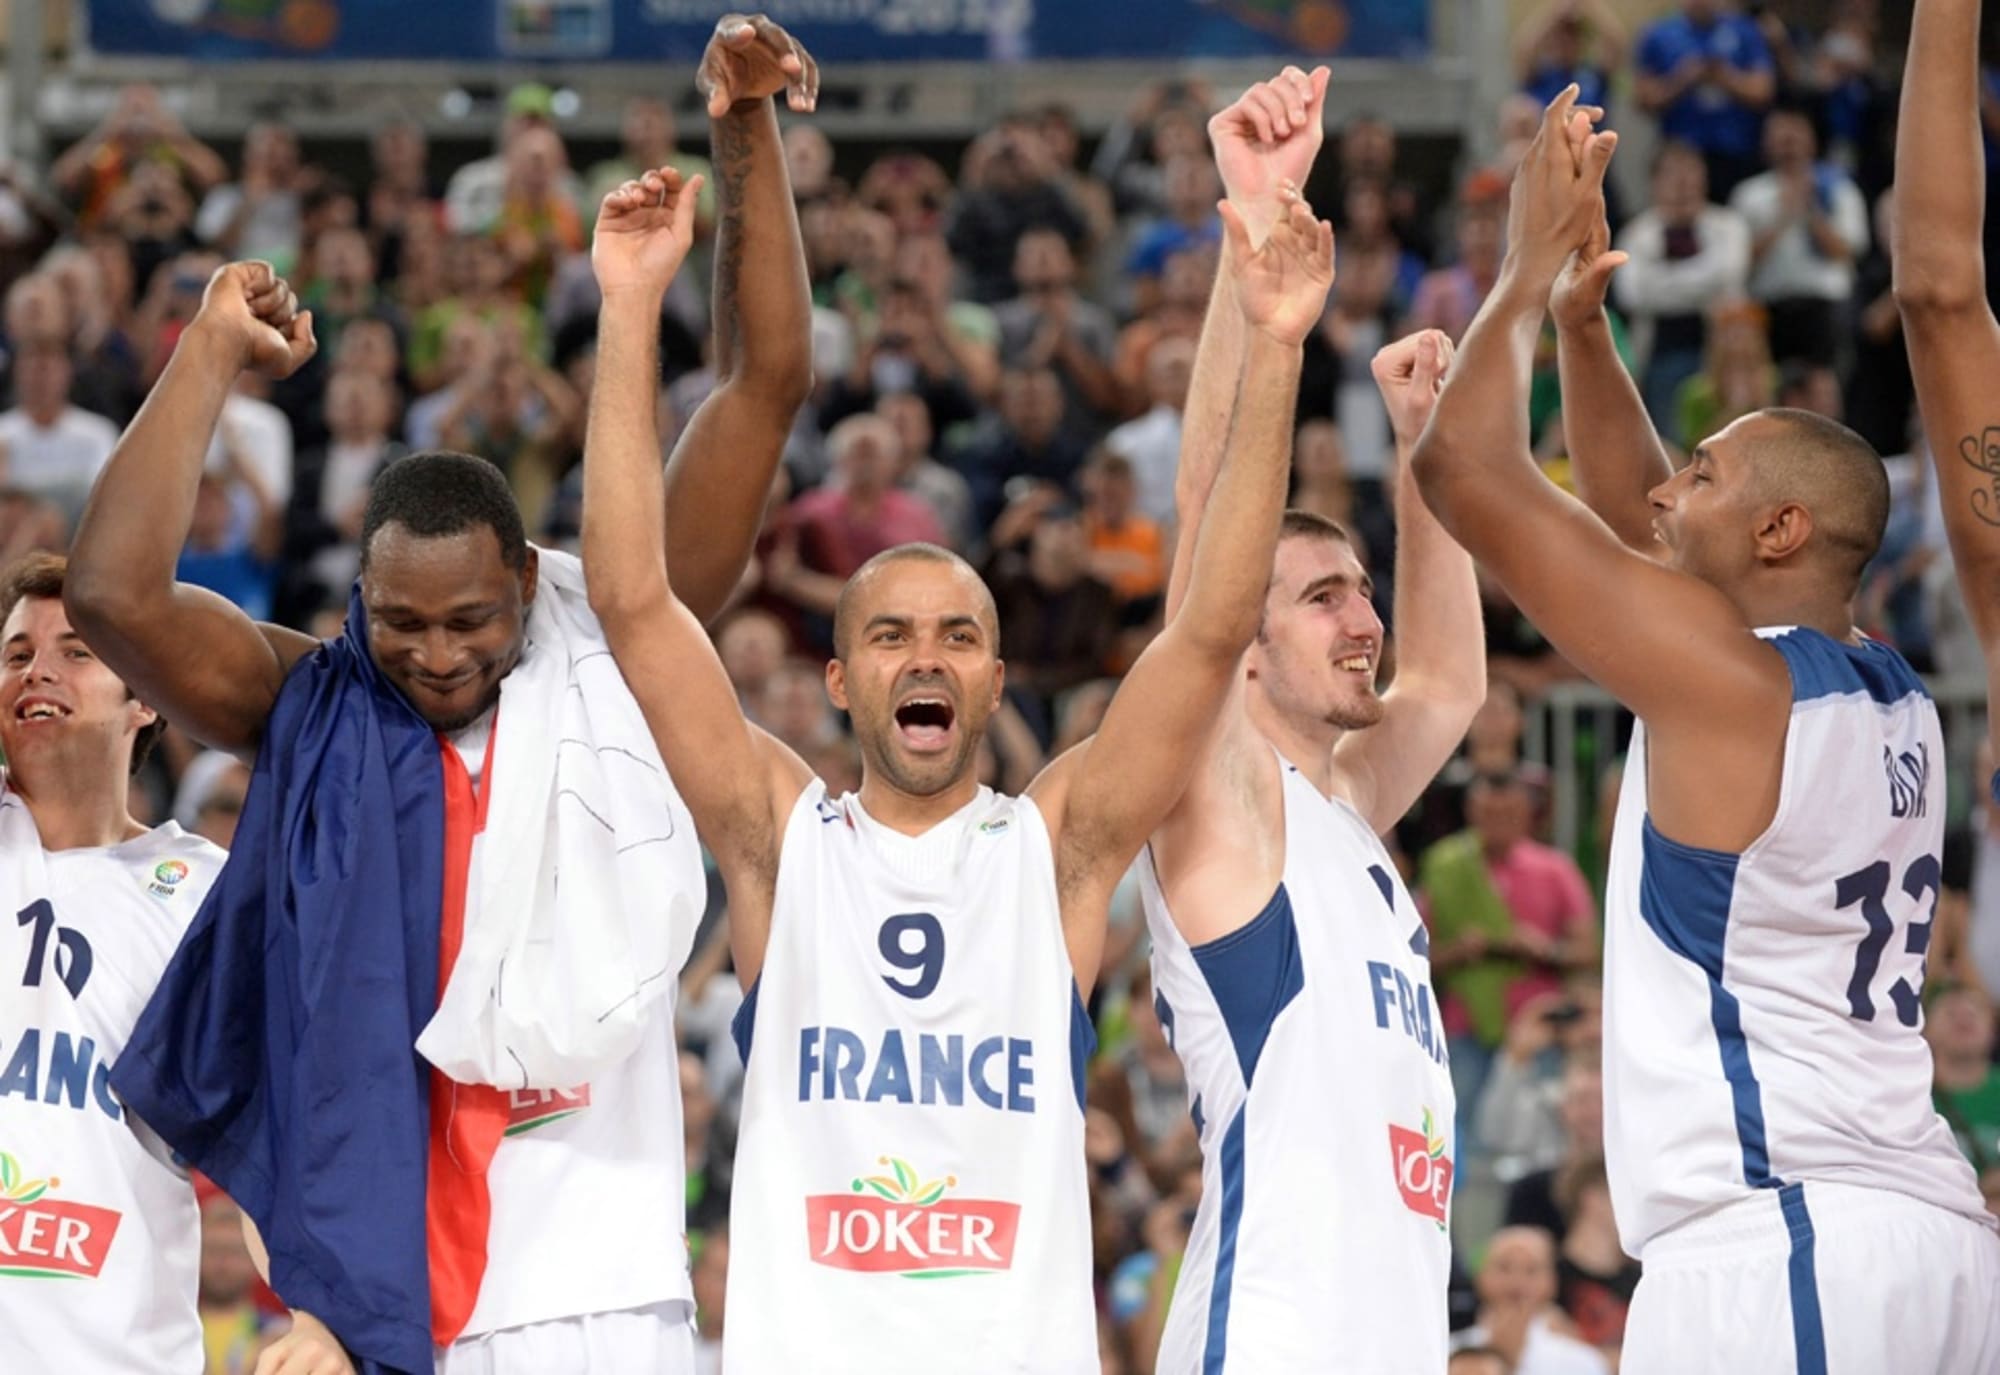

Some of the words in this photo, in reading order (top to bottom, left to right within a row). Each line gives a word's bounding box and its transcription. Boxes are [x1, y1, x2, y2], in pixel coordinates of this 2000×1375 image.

[16, 897, 94, 1001] 10
[877, 912, 946, 1001] 9
[1834, 853, 1942, 1028] 13
[799, 1025, 1037, 1114] FRANCE
[820, 1208, 1001, 1260] JOKER
